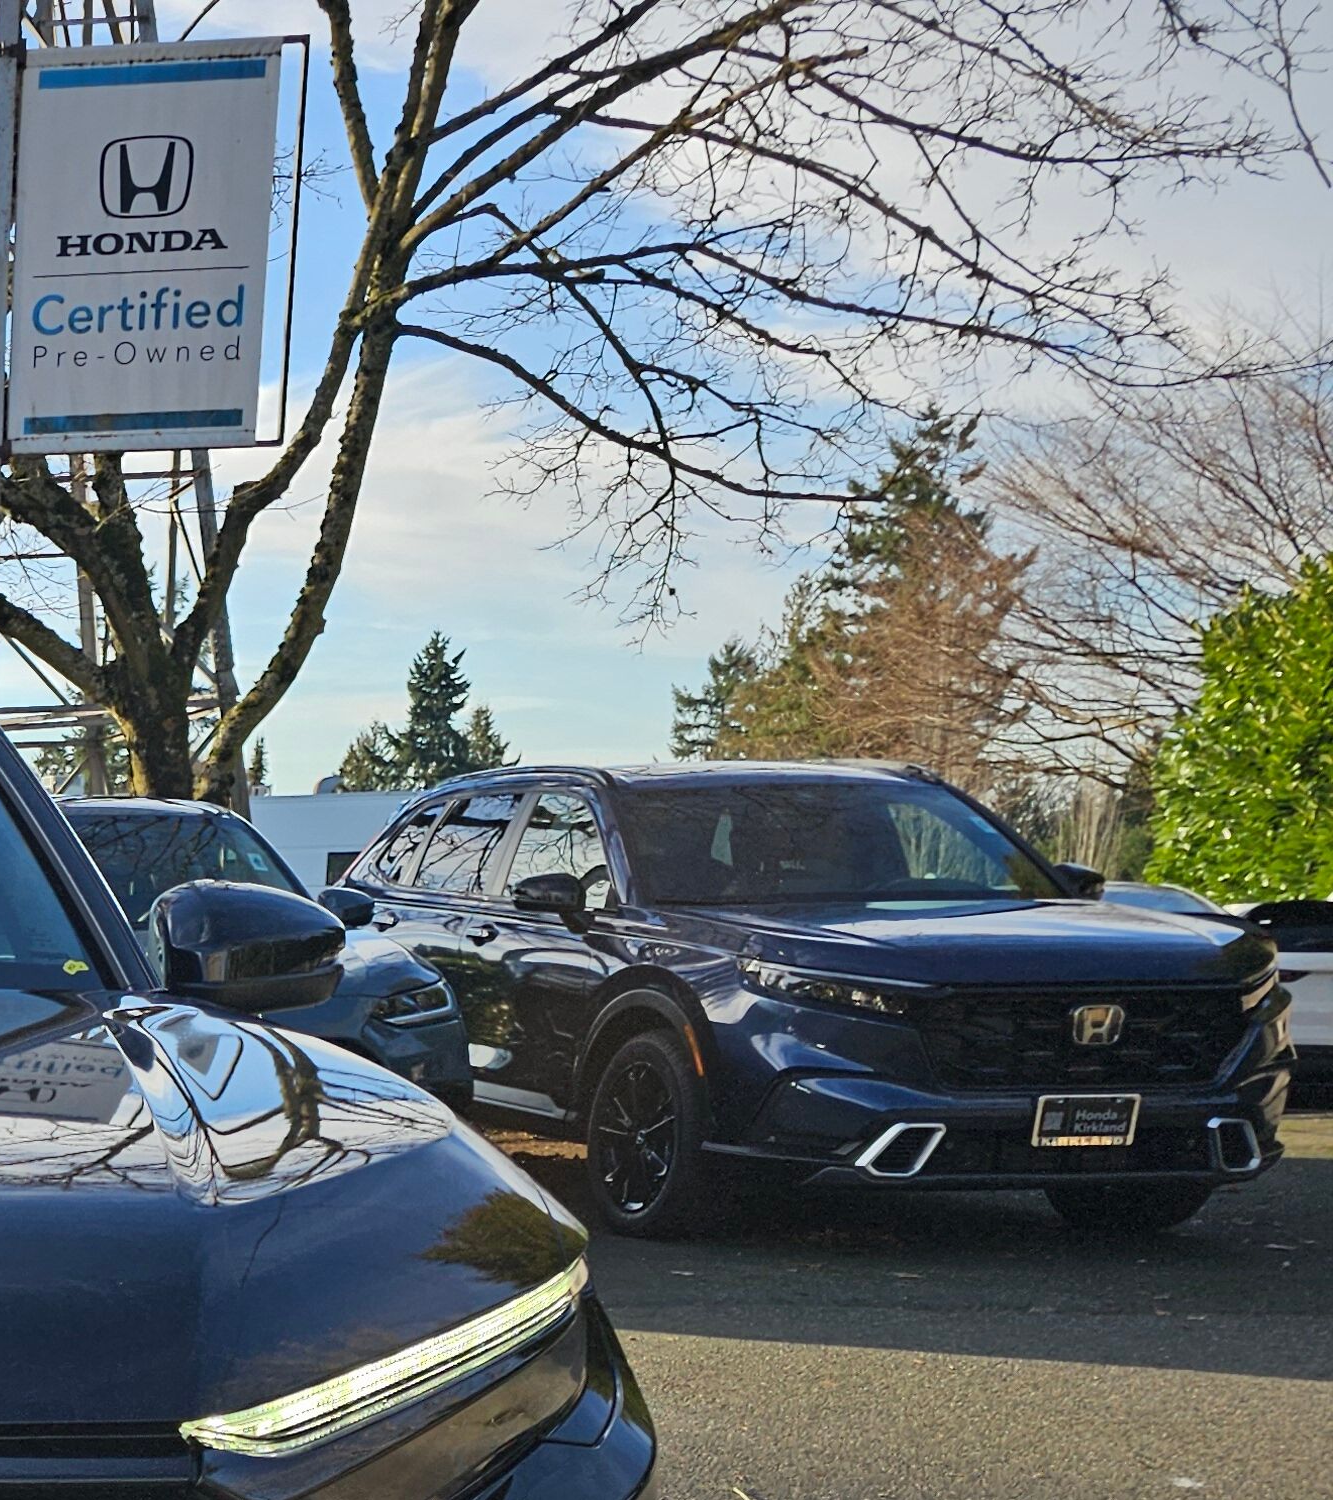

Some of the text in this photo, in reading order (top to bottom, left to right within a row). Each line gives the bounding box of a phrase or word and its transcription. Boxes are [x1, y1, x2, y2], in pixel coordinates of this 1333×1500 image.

[56, 228, 228, 258] HONDA
[32, 284, 245, 336] Certified
[32, 336, 242, 368] Pre-Owned
[1074, 1121, 1128, 1133] Kirkland
[1076, 1108, 1118, 1120] Honda
